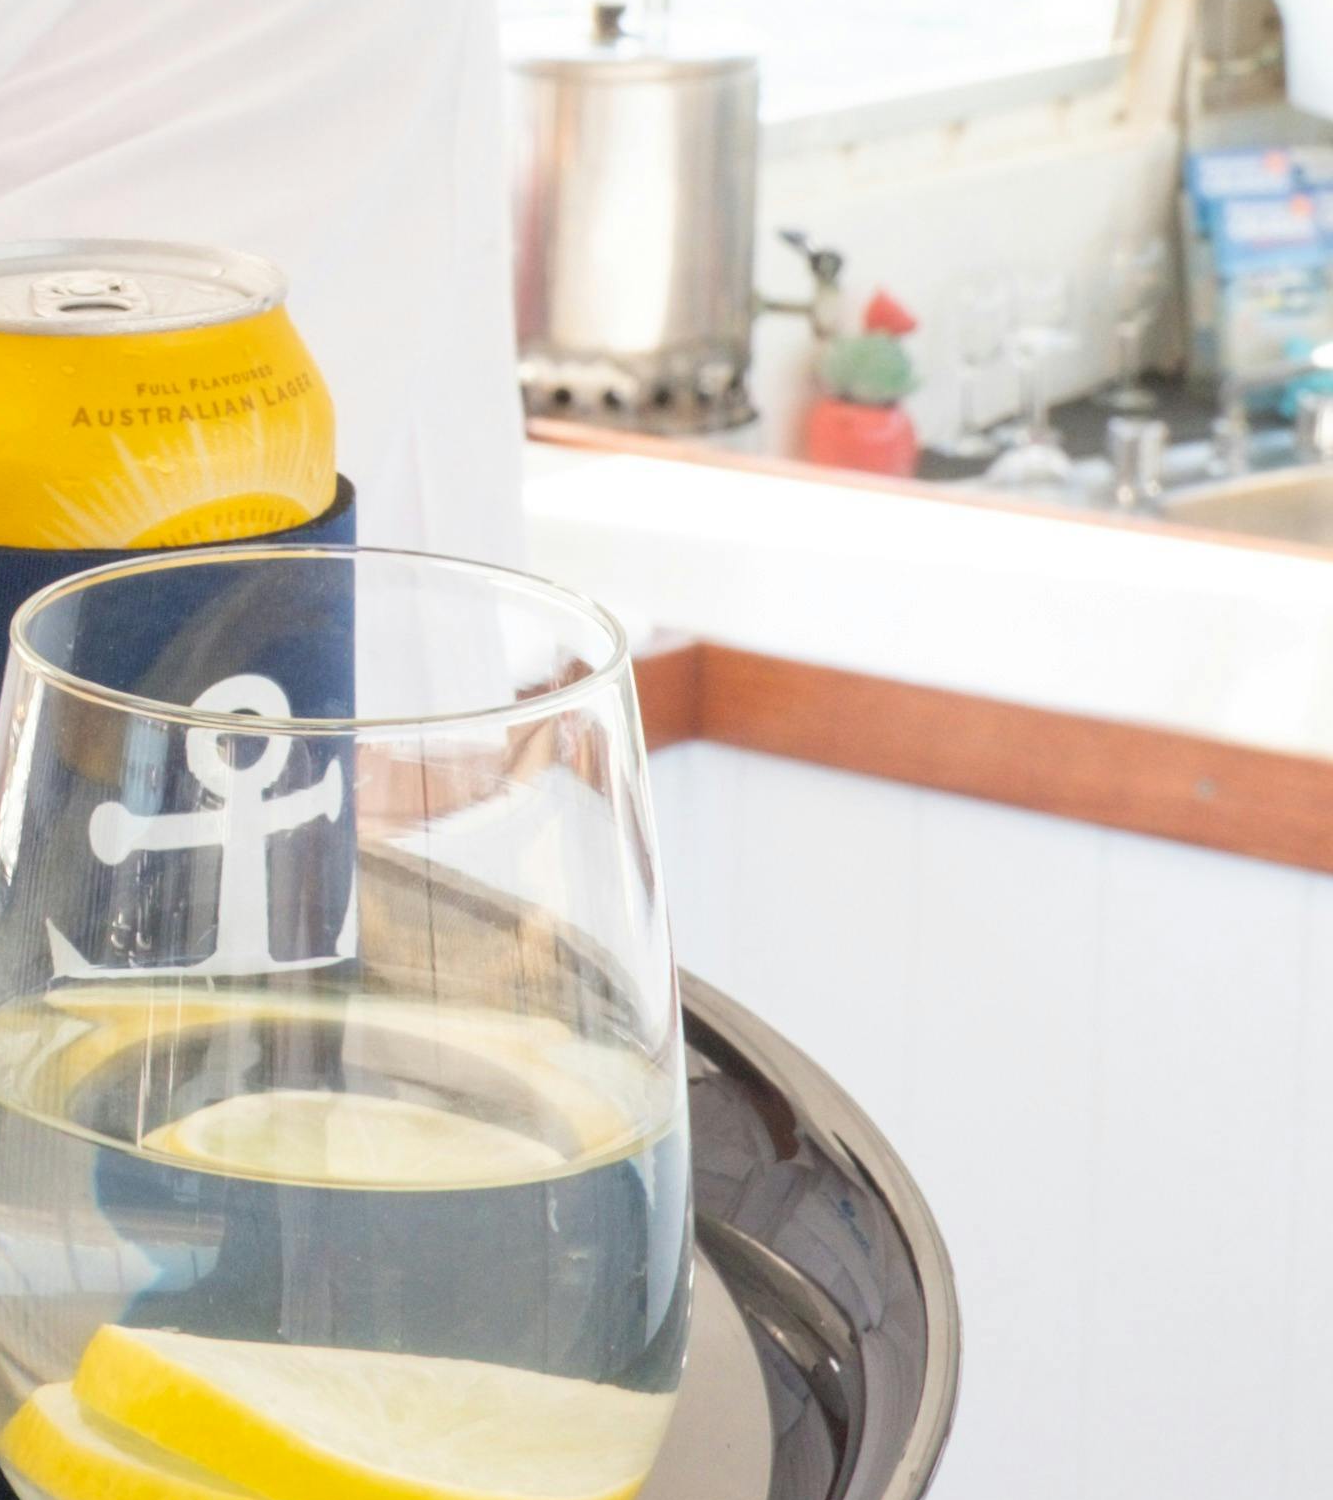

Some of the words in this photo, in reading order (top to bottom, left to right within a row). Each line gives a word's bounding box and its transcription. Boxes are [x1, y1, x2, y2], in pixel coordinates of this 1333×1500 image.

[71, 393, 256, 428] AUSTRALIAN
[260, 372, 312, 407] LAGER
[136, 382, 181, 398] FULL
[189, 365, 273, 392] FLAVOURED
